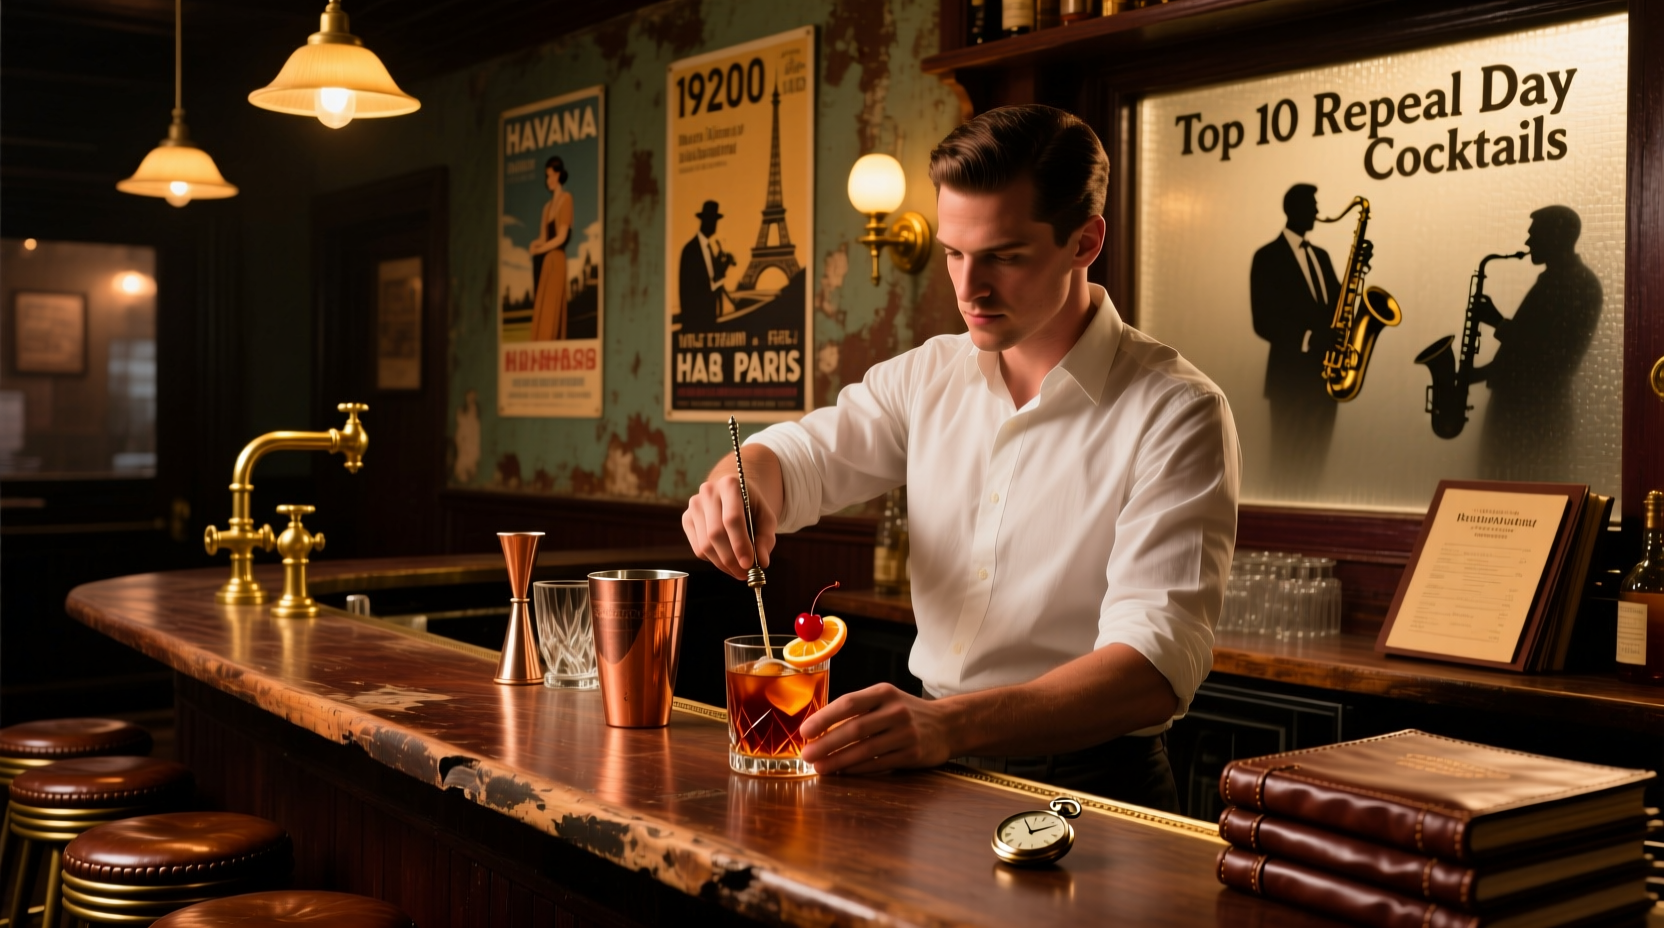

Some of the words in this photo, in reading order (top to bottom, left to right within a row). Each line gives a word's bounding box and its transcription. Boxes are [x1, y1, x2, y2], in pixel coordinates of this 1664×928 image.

[676, 57, 766, 119] 19200
[1175, 111, 1245, 162] Top
[1256, 98, 1299, 146] 10
[1312, 70, 1463, 140] Repeal
[1479, 63, 1578, 116] Day
[505, 105, 598, 156] HAVANA
[1363, 114, 1569, 181] Cocktails
[733, 349, 802, 384] PARIS
